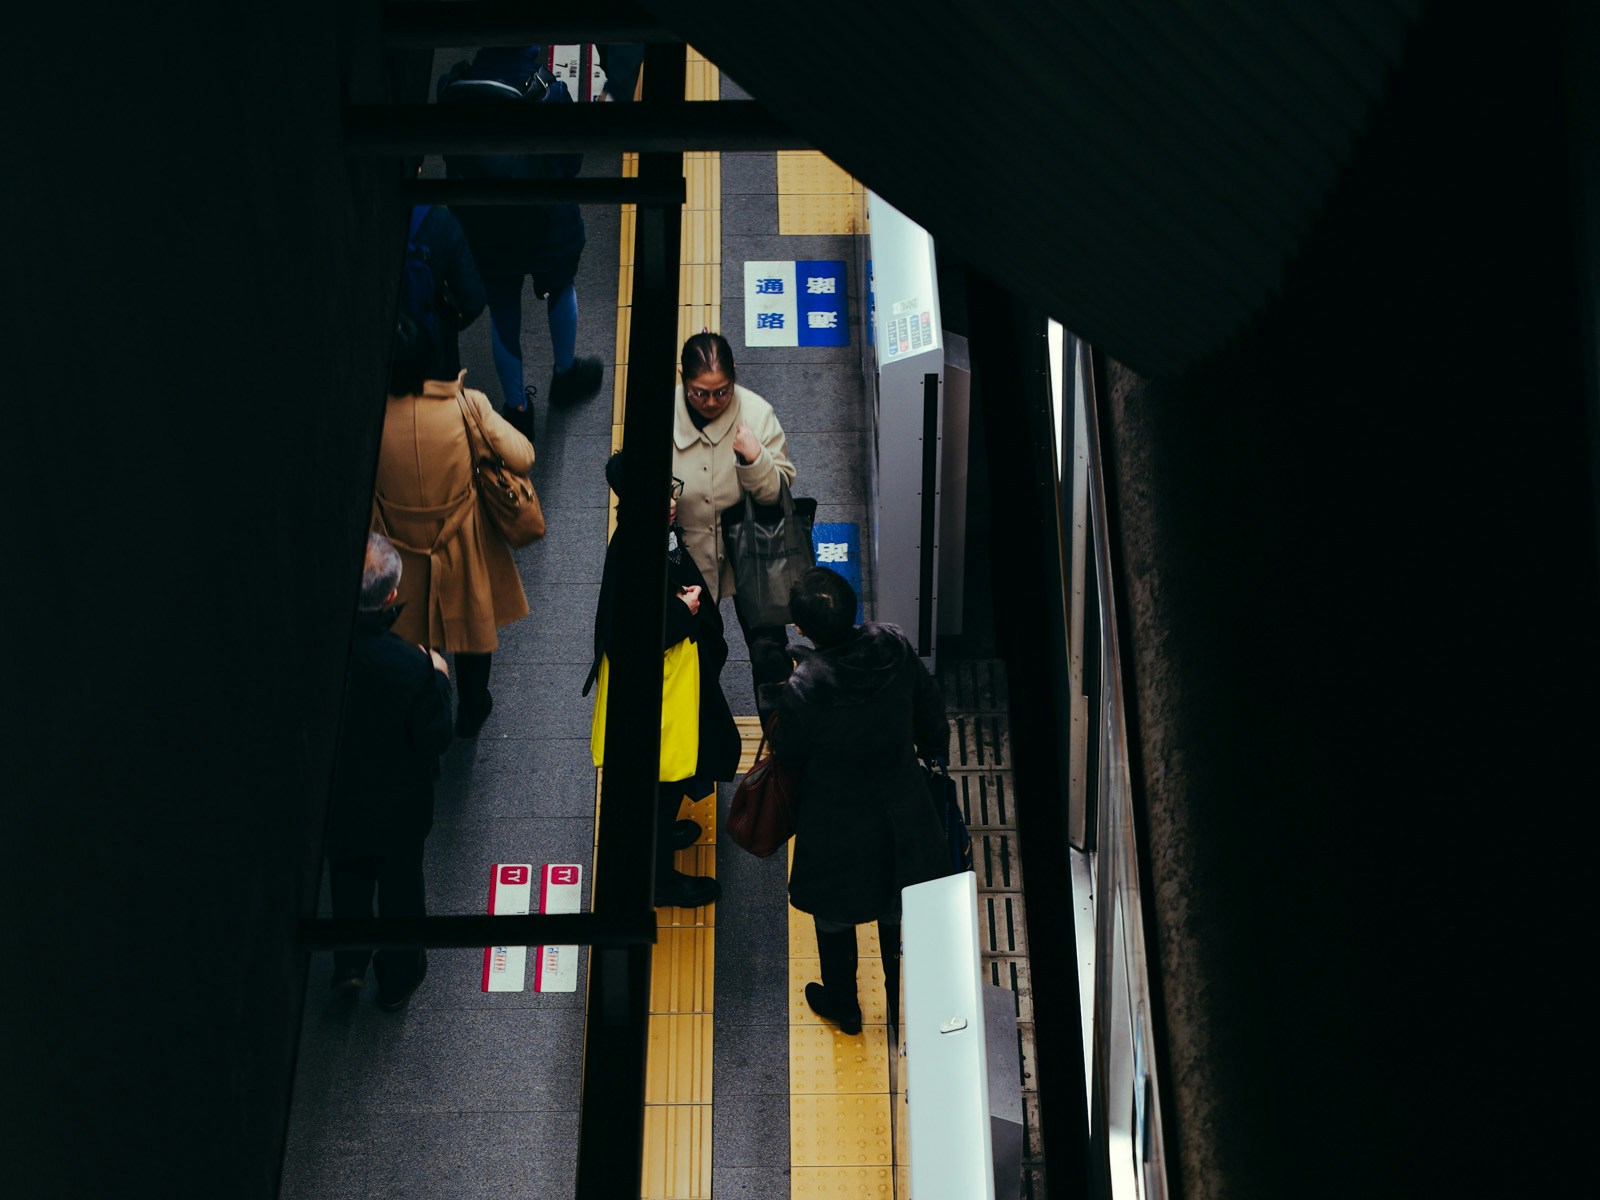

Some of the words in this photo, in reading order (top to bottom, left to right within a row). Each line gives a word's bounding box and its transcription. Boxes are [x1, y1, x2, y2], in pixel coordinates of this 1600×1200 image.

[756, 278, 785, 329] 通路
[806, 277, 838, 329] 通路
[816, 543, 848, 562] 路
[508, 868, 520, 882] TY
[558, 868, 571, 882] TY
